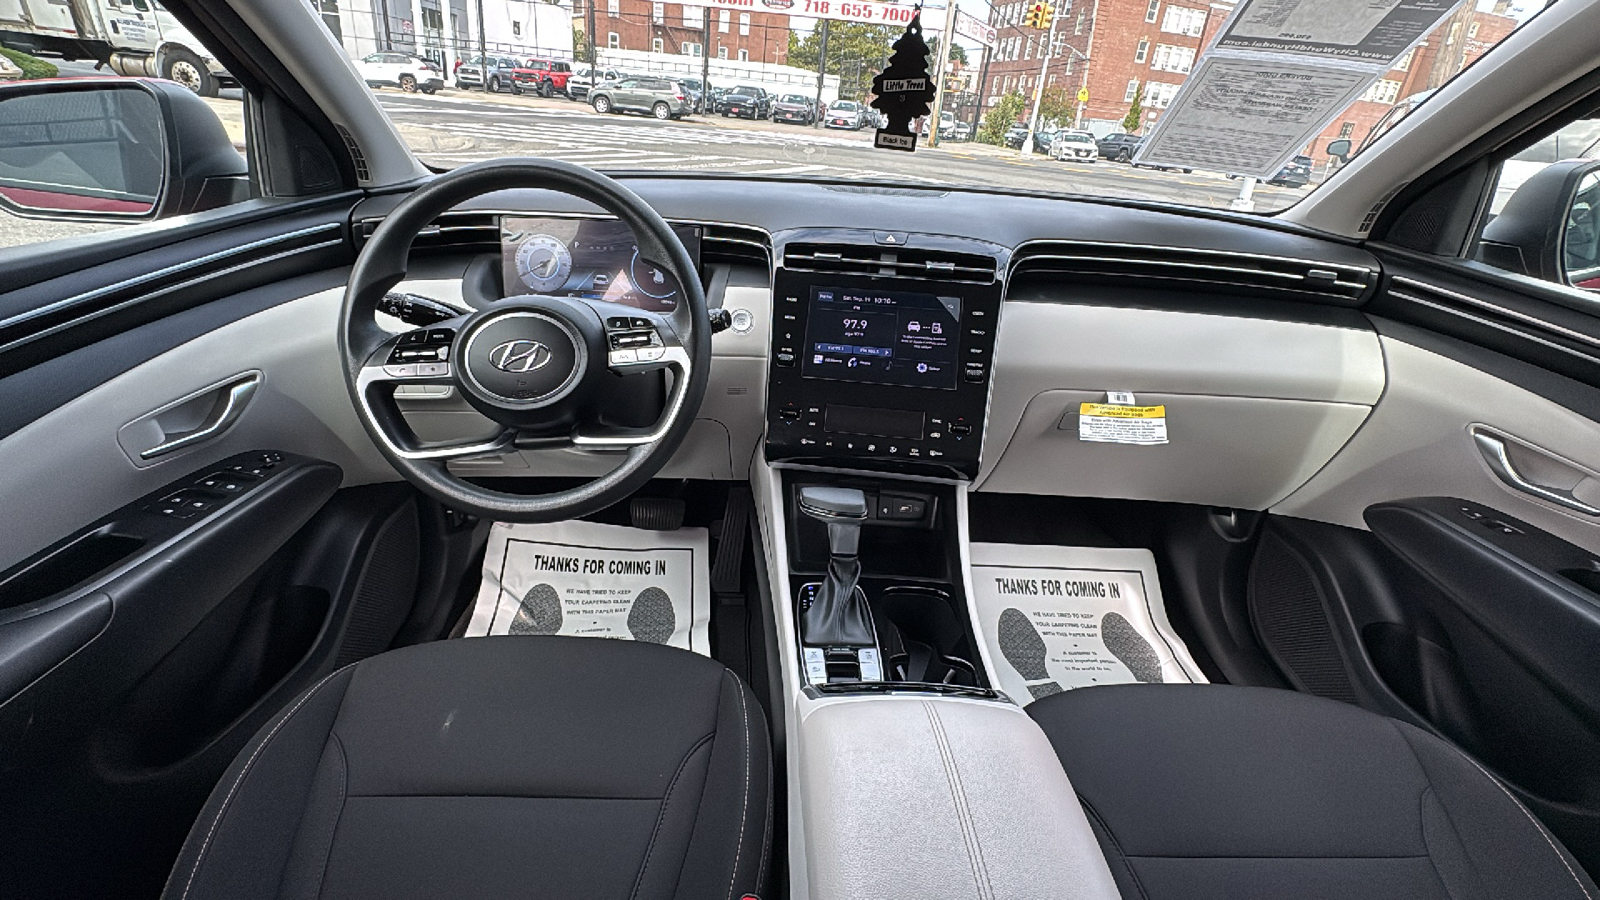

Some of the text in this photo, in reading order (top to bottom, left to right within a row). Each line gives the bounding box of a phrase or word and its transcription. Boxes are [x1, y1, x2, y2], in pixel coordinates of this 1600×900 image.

[885, 80, 924, 91] Little Trees
[882, 136, 898, 144] Black
[843, 318, 868, 330] 97.9
[534, 555, 666, 575] THANKS FOR COMING IN
[995, 578, 1120, 599] THANKS FOR COMING IN
